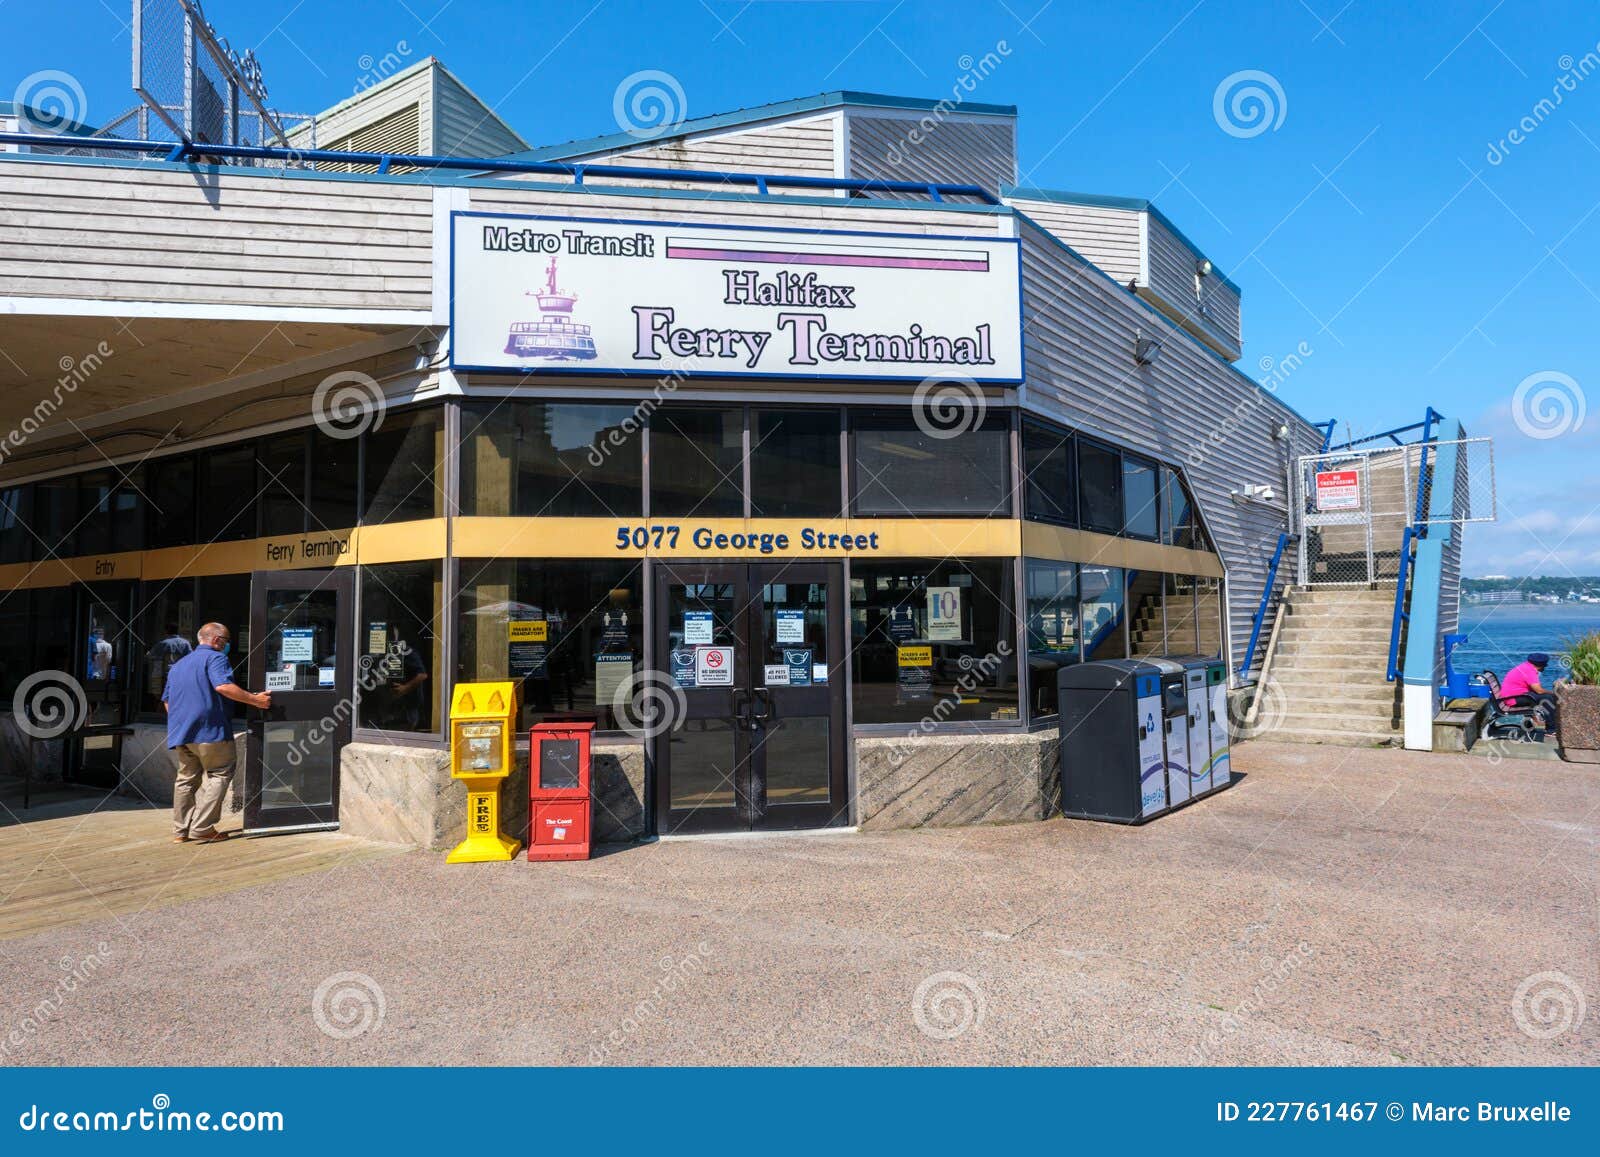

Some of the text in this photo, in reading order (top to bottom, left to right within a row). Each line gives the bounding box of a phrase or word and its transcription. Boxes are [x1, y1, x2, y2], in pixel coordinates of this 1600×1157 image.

[483, 226, 654, 258] Metro Transit
[723, 270, 856, 308] Halifax
[632, 306, 996, 368] Ferry Terminal
[267, 537, 350, 563] Ferry Terminal
[616, 526, 879, 554] 5077 George Street
[95, 559, 116, 577] Entry
[477, 798, 489, 832] FREE
